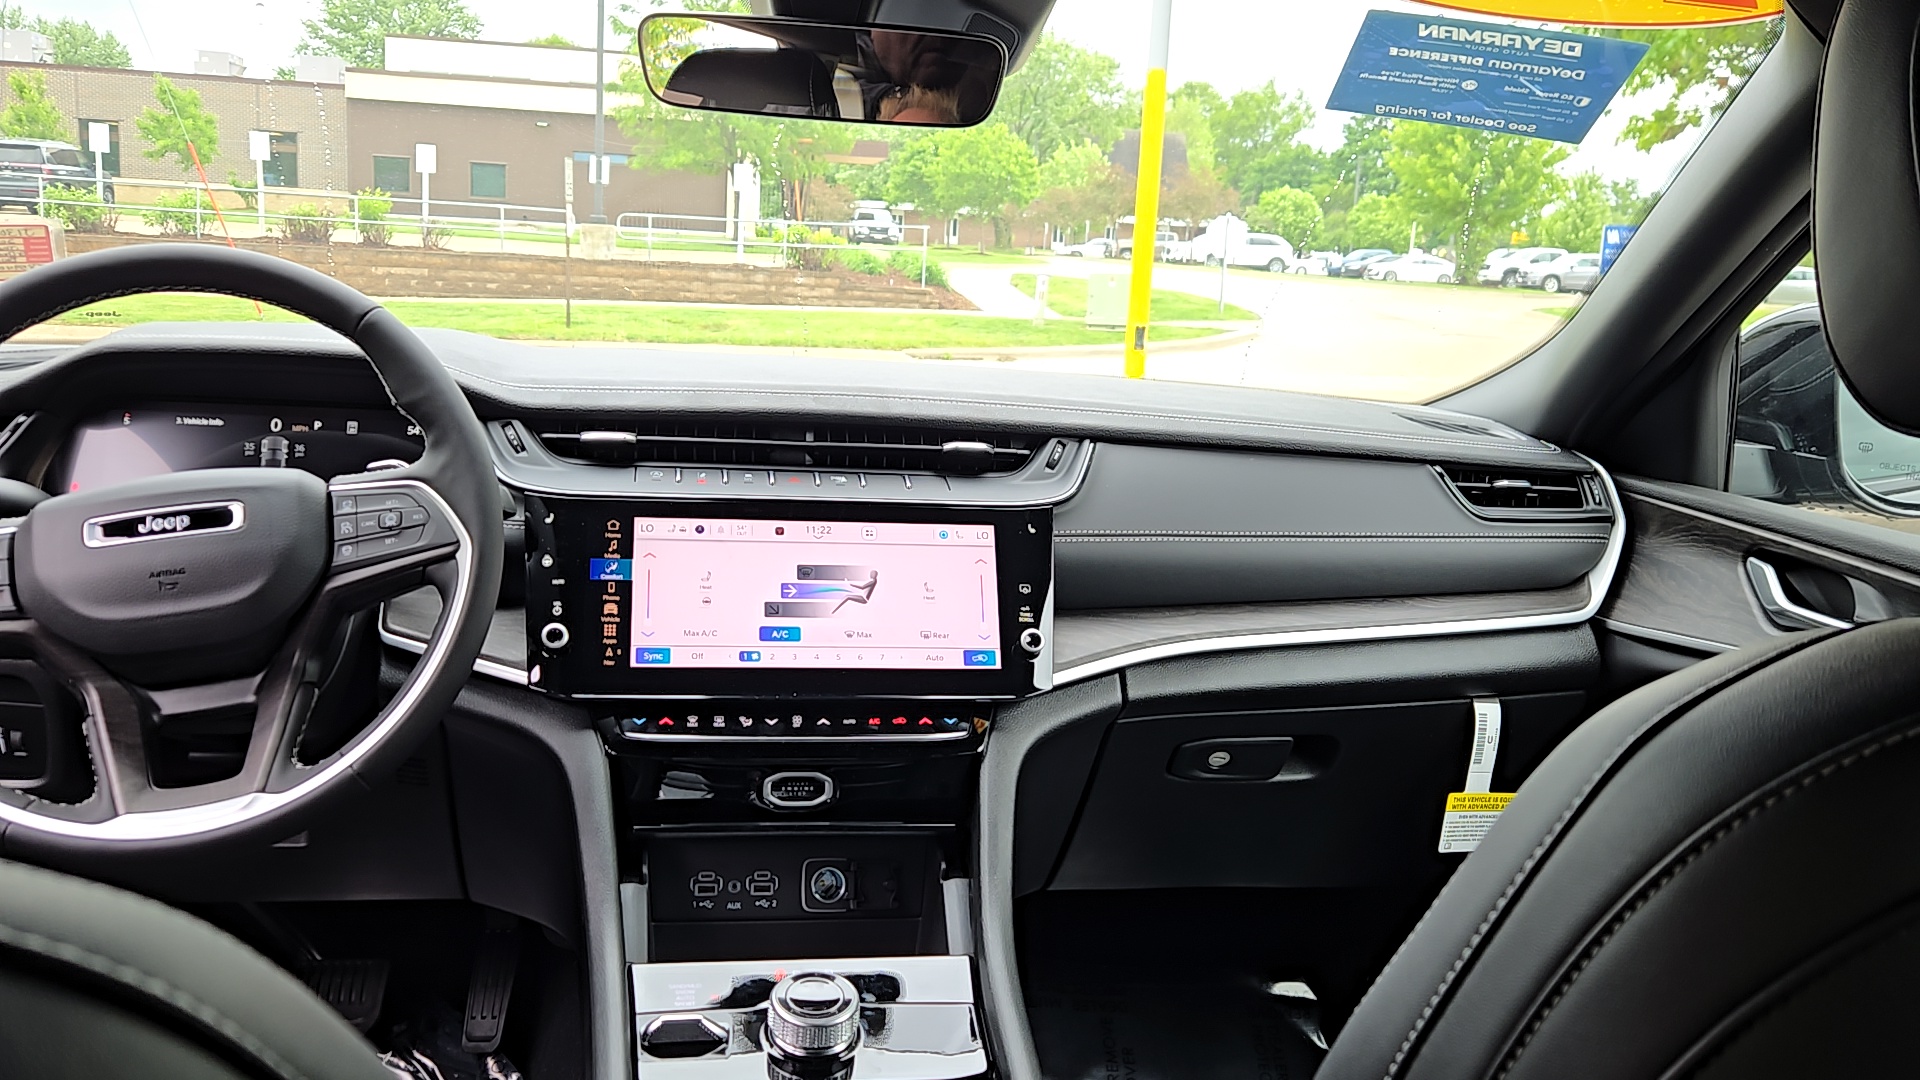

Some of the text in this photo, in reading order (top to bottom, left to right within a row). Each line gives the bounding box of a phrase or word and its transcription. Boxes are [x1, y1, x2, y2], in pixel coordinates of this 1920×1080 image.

[183, 416, 208, 426] Vehicle
[270, 418, 283, 432] 0
[313, 420, 322, 431] P
[243, 443, 256, 451] 35
[294, 444, 306, 452] 36
[1879, 462, 1917, 473] OBJECTS
[137, 514, 191, 534] Jeep
[640, 525, 654, 533] LO
[806, 526, 832, 535] 11:22
[976, 531, 989, 540] LO
[148, 567, 187, 579] AIRBAG
[701, 630, 718, 638] A/C
[771, 630, 789, 639] A/C
[857, 631, 873, 639] Max
[643, 652, 664, 661] Sync
[691, 652, 704, 660] Off
[925, 654, 944, 662] Auto
[771, 900, 777, 908] 2
